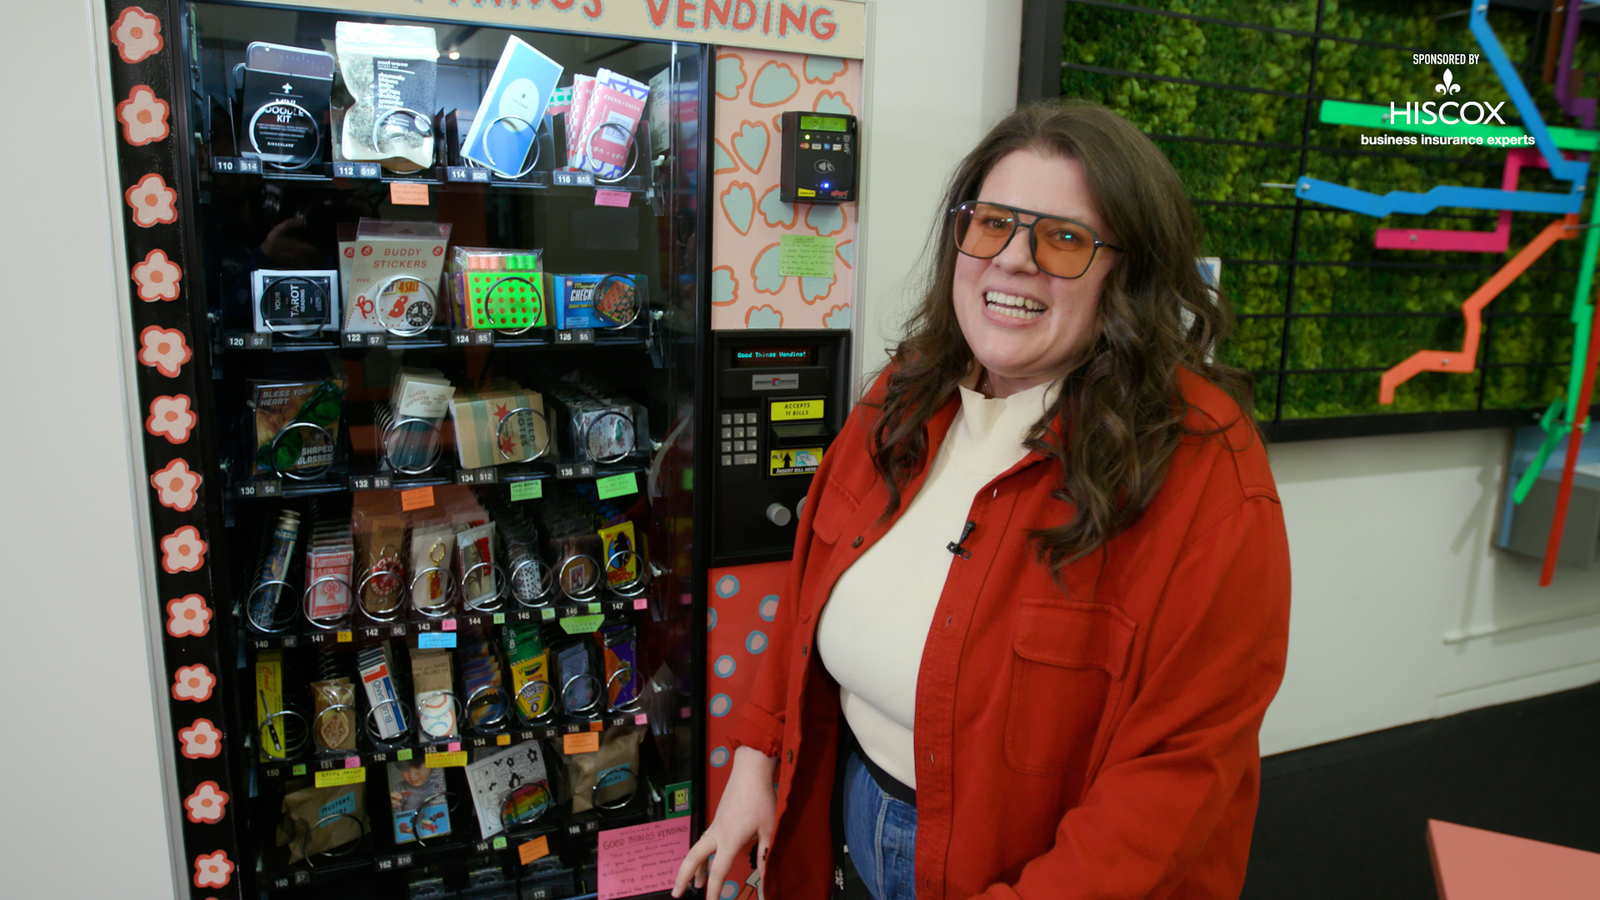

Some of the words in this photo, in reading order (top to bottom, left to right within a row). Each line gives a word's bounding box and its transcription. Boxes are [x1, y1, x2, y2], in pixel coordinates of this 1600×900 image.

[645, 0, 838, 41] VENDING
[276, 114, 292, 123] KIT
[218, 161, 233, 170] 110
[241, 162, 258, 172] $14
[339, 166, 354, 175] 112
[452, 171, 466, 179] 114
[473, 172, 486, 180] $20
[384, 248, 422, 256] BUDDY
[373, 260, 428, 268] STICKERS
[274, 290, 282, 310] YOUR
[290, 284, 300, 318] TAROT
[347, 334, 361, 342] 122
[370, 336, 380, 344] $7
[456, 335, 470, 344] 124
[478, 334, 488, 342] $5
[559, 332, 572, 341] 126
[580, 333, 589, 341] $5
[230, 337, 244, 346] 120
[254, 337, 264, 346] $7
[262, 390, 290, 398] BLESS
[293, 387, 314, 396] YOUR
[260, 398, 290, 406] HEART
[784, 402, 811, 410] ACCEPTS
[518, 410, 528, 447] NOTES
[526, 411, 536, 442] FIELD
[302, 445, 333, 456] SHAPED
[297, 454, 333, 466] GLASSES
[560, 468, 574, 476] 136
[460, 474, 474, 482] 134
[479, 472, 492, 481] $12
[354, 480, 368, 488] 132
[374, 479, 388, 488] $15
[240, 486, 255, 495] 130
[264, 485, 275, 494] $8
[274, 530, 298, 540] PUZZLE
[612, 602, 624, 610] 147
[518, 612, 530, 620] 145
[566, 608, 578, 616] 146
[468, 617, 481, 626] 144
[366, 628, 379, 637] 142
[393, 626, 402, 634] $6
[418, 624, 430, 632] 143
[311, 634, 324, 643] 141
[254, 640, 268, 649] 140
[284, 638, 294, 646] $9
[509, 638, 516, 650] 8
[613, 718, 624, 726] 157
[521, 732, 534, 740] 155
[473, 738, 486, 746] 154
[424, 746, 436, 754] 153
[374, 754, 386, 762] 152
[320, 760, 334, 769] 151
[266, 769, 280, 778] 150
[322, 796, 351, 814] MYSTERY
[568, 825, 580, 834] 166
[586, 822, 595, 830] $7
[602, 838, 626, 850] GOOD
[628, 832, 656, 844] THINGS
[657, 824, 688, 838] VENDING
[476, 842, 488, 852] 164
[639, 850, 675, 860] experiencing
[378, 860, 392, 870] 162
[398, 856, 411, 865] $10
[275, 878, 288, 888] 160
[296, 874, 306, 882] $7
[533, 891, 546, 900] 172
